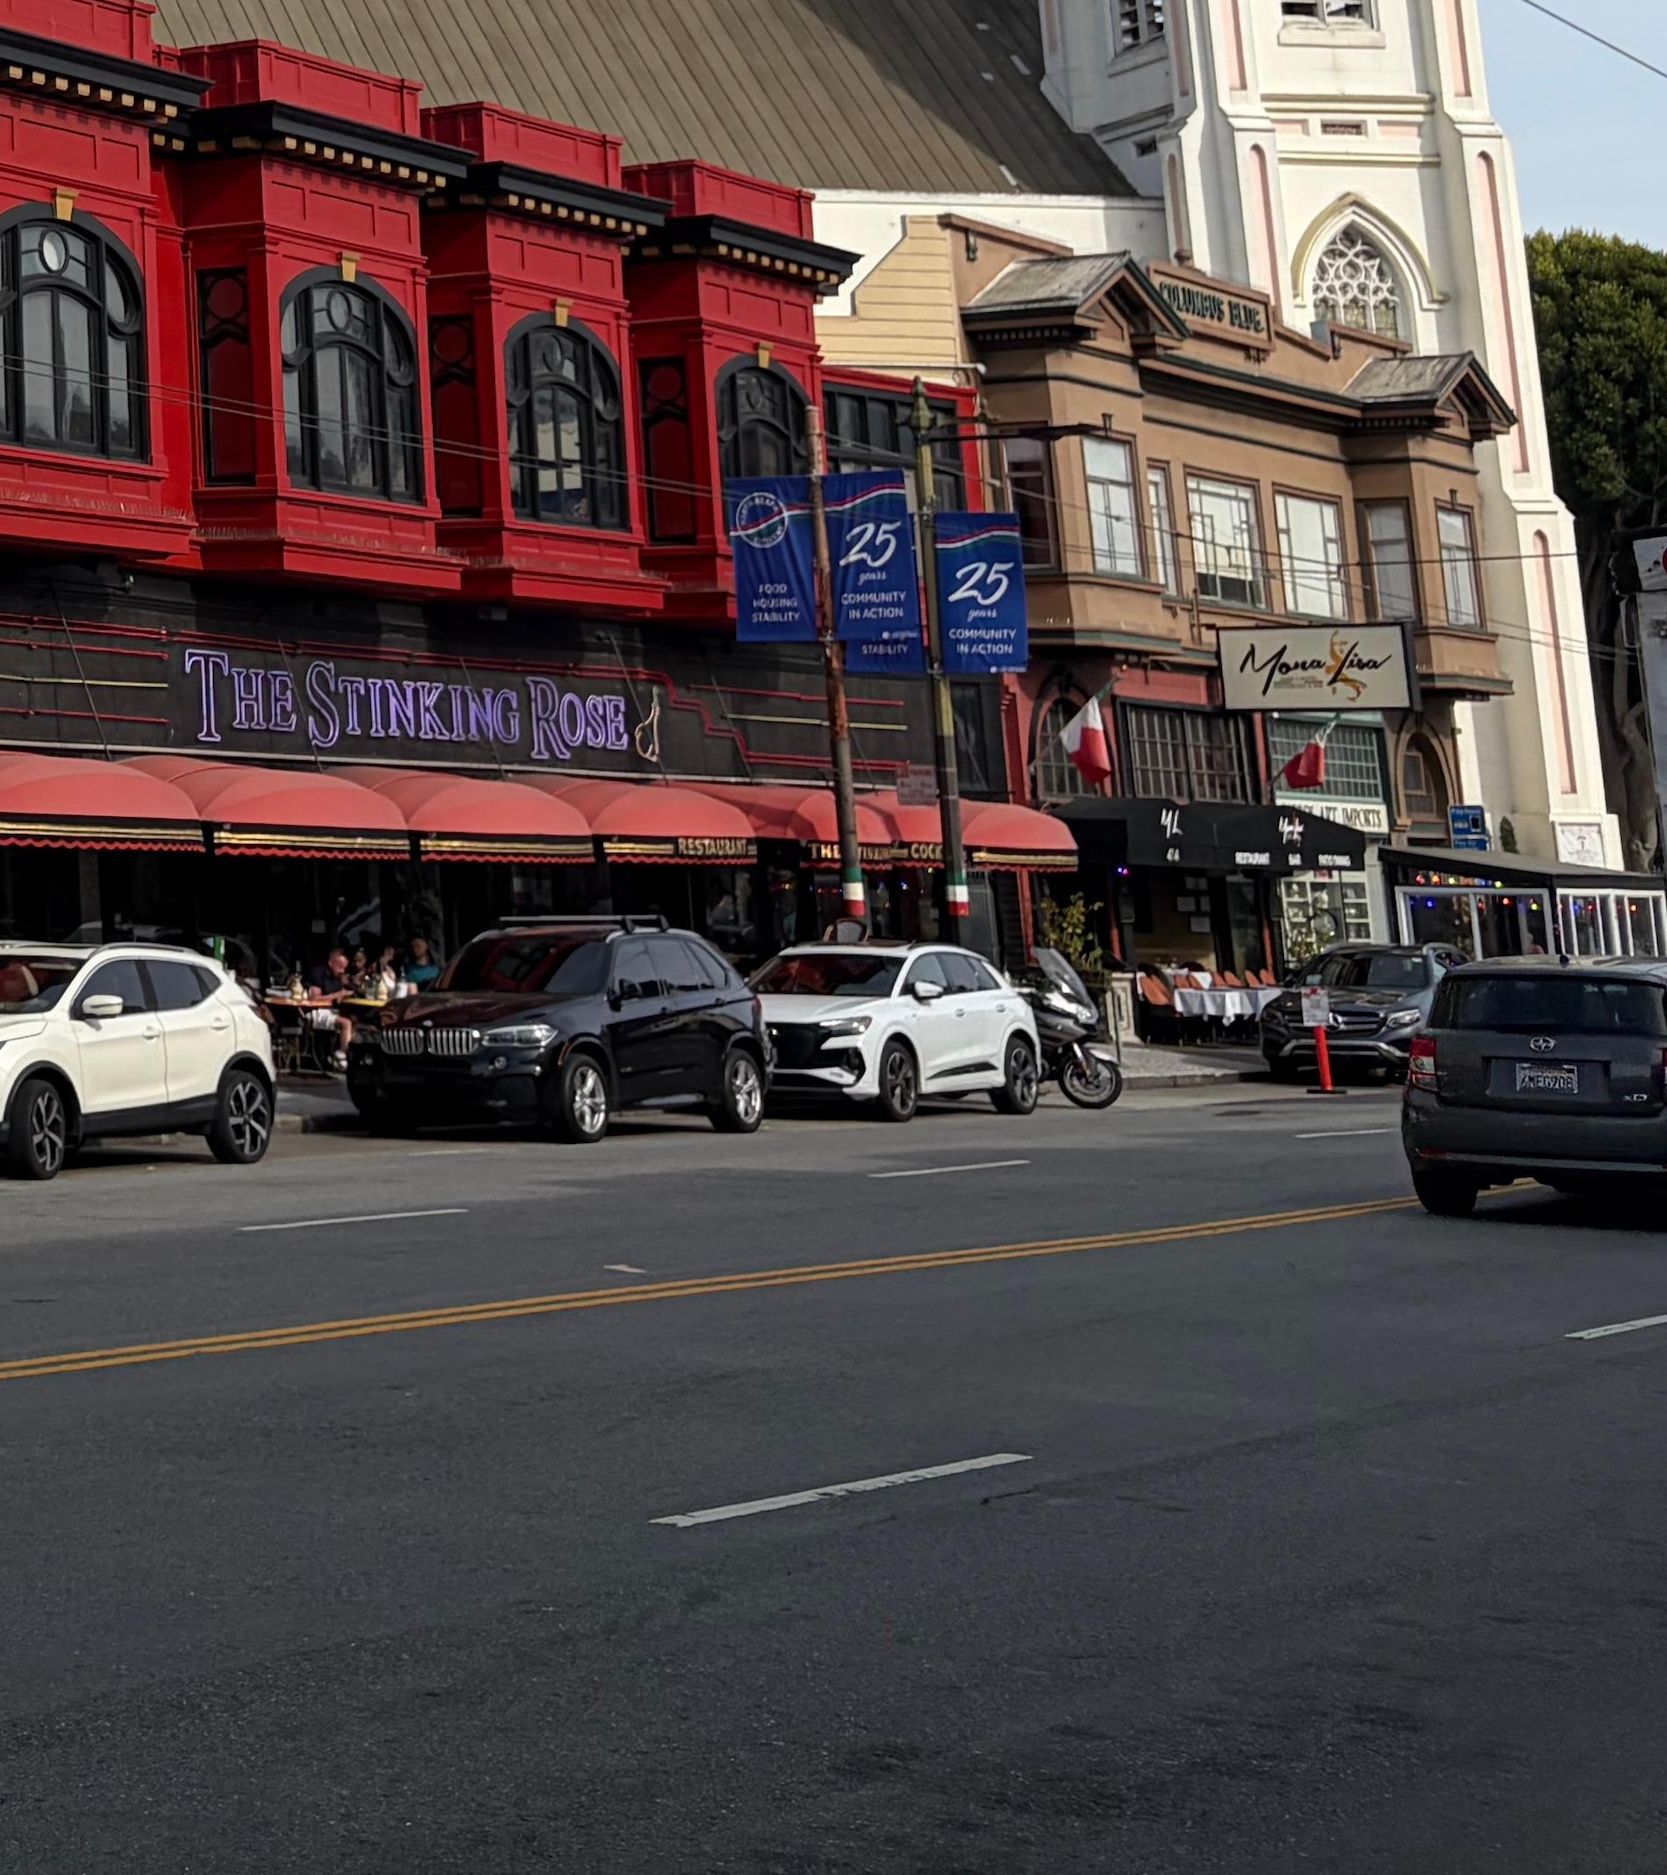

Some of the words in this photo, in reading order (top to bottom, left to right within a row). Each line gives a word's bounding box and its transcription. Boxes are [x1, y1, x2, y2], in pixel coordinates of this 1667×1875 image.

[838, 520, 902, 567] 25
[758, 583, 788, 594] FOOD
[947, 561, 1015, 606] 25
[752, 597, 798, 609] HOUSING
[840, 591, 907, 605] COMMUNITY
[752, 611, 800, 623] STABILITY
[848, 609, 861, 620] IN
[862, 607, 904, 619] ACTION
[948, 628, 1017, 640] COMMUNITY
[956, 643, 970, 654] IN
[970, 643, 1014, 654] ACTION
[1239, 643, 1326, 697] Mona
[1326, 641, 1393, 686] Lisa
[184, 648, 297, 742] THE
[306, 660, 520, 749] STINKING
[526, 674, 629, 761] ROSE
[676, 837, 748, 859] RESTAURANT
[809, 842, 842, 860] THE
